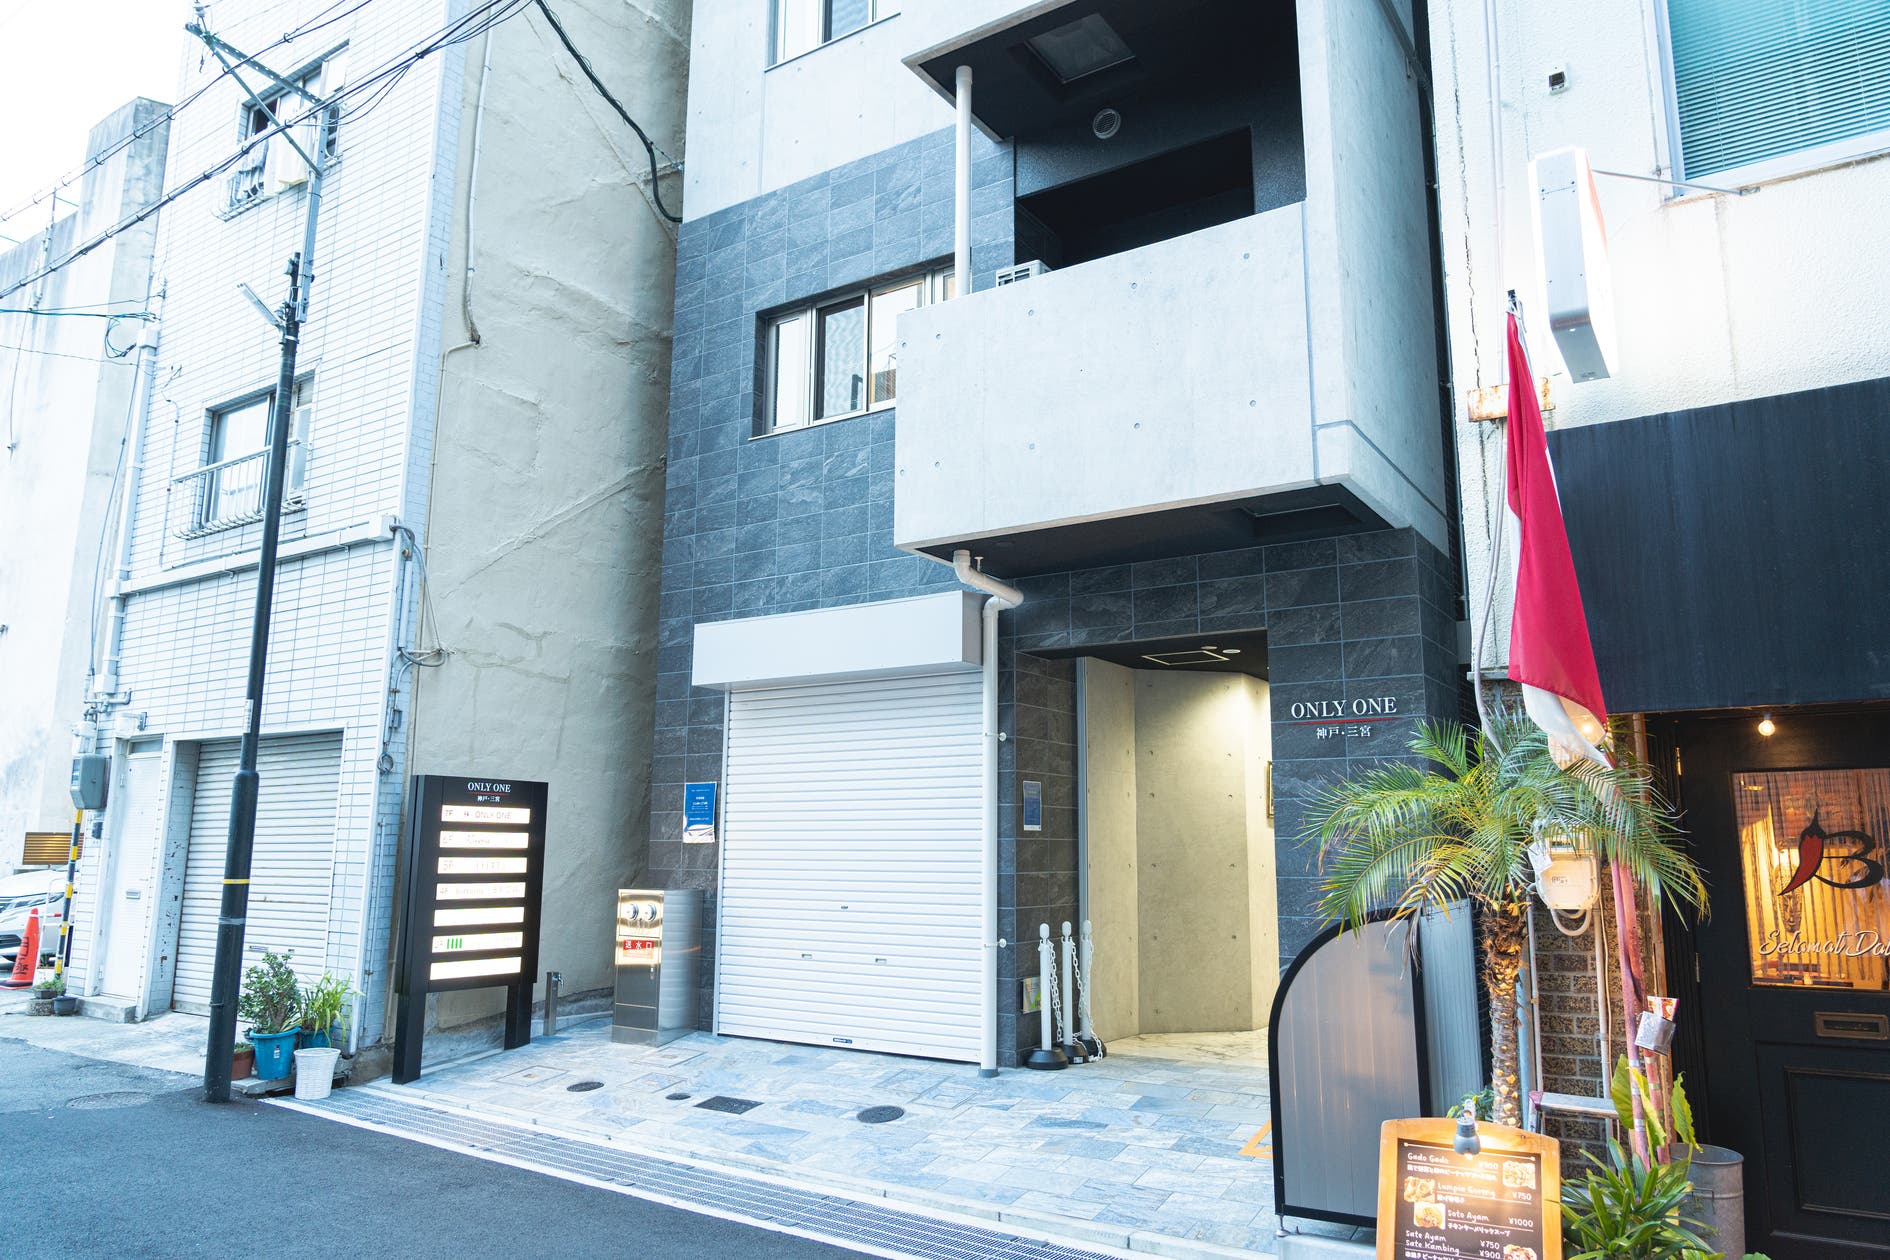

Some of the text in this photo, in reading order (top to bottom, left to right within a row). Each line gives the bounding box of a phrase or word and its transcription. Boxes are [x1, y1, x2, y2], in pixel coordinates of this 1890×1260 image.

[1290, 696, 1398, 719] ONLY ONE
[467, 781, 511, 793] ONLY ONE
[1759, 929, 1852, 956] Selamat
[1407, 1152, 1427, 1162] Gado
[1512, 1191, 1532, 1201] ¥750
[1447, 1209, 1490, 1223] Soto Ayam
[1508, 1217, 1534, 1228] ¥1000
[1405, 1230, 1447, 1244] Sate Ayam
[1405, 1239, 1423, 1248] Sate
[1424, 1241, 1460, 1256] Kambing
[1480, 1240, 1500, 1250] ¥750
[1479, 1249, 1501, 1259] ¥900
